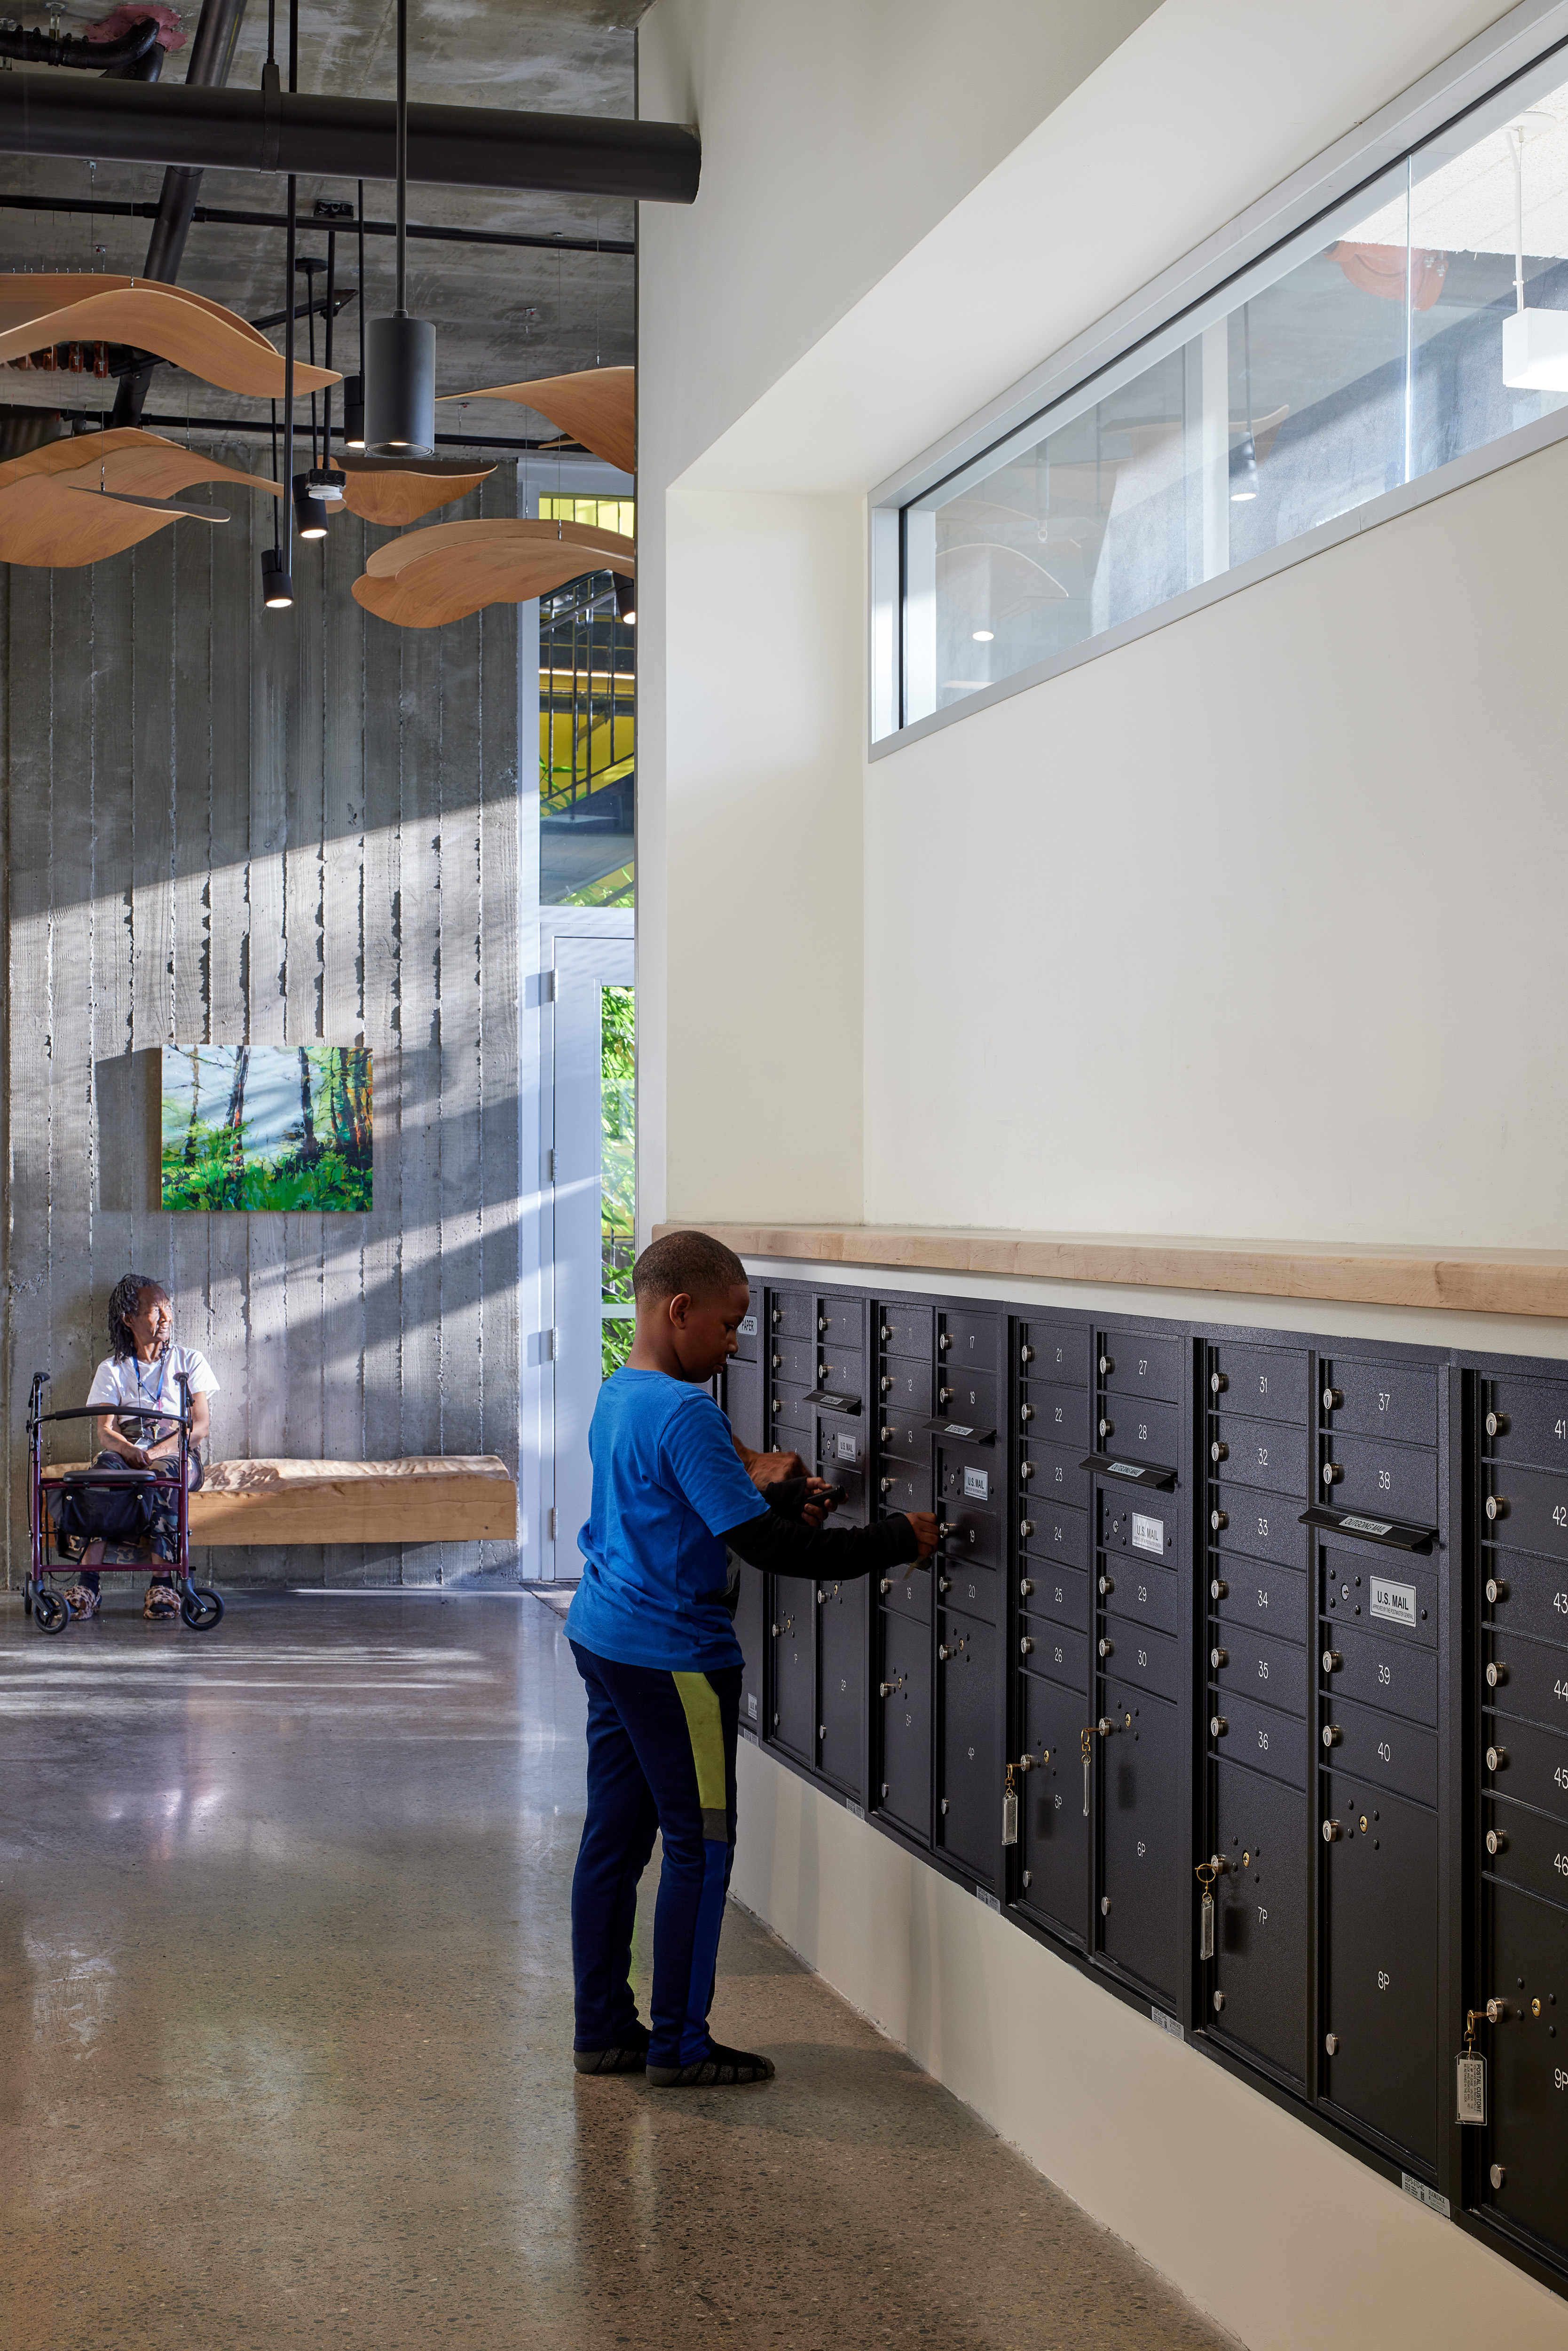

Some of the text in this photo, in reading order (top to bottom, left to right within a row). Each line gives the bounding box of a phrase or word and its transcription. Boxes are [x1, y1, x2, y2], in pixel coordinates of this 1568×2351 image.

[969, 1336, 975, 1349] 17
[1056, 1348, 1062, 1362] 21
[1139, 1360, 1147, 1375] 27
[1260, 1376, 1267, 1393] 31
[970, 1391, 975, 1404] 18
[1379, 1393, 1390, 1411] 37
[1055, 1407, 1062, 1422] 22
[908, 1430, 913, 1443] 13
[1139, 1424, 1147, 1440] 28
[1554, 1420, 1566, 1440] 41
[1258, 1448, 1268, 1466] 32
[1056, 1467, 1063, 1482] 23
[1111, 1464, 1132, 1473] OUTGOING
[976, 1478, 984, 1489] MAIL
[1379, 1470, 1390, 1490] 38
[908, 1483, 913, 1495] 14
[1345, 1519, 1374, 1530] OUTGOING
[1552, 1506, 1567, 1527] 42
[1055, 1526, 1062, 1542] 24
[1137, 1525, 1158, 1541] U.S. MAIL
[1258, 1518, 1268, 1536] 33
[969, 1530, 975, 1543] 19
[969, 1584, 976, 1598] 20
[1055, 1587, 1063, 1602] 25
[1138, 1586, 1147, 1602] 29
[1258, 1590, 1268, 1608] 34
[1378, 1591, 1409, 1610] U.S. MAIL
[1553, 1592, 1568, 1614] 43
[1055, 1647, 1062, 1663] 26
[1138, 1649, 1147, 1667] 30
[1258, 1660, 1269, 1679] 35
[1378, 1665, 1390, 1685] 39
[841, 1679, 846, 1691] 2P
[1554, 1680, 1568, 1702] 44
[906, 1714, 911, 1727] 3P
[1258, 1731, 1269, 1750] 36
[968, 1747, 975, 1760] 4P
[1378, 1742, 1390, 1762] 40
[1554, 1767, 1568, 1789] 45
[1055, 1794, 1062, 1810] 5P
[1137, 1841, 1146, 1857] 6P
[1554, 1853, 1568, 1876] 46
[1258, 1906, 1268, 1925] 7P
[1378, 1971, 1390, 1990] 8P
[1554, 2068, 1568, 2091] 9P
[1404, 2174, 1425, 2191] USPS-STD-4C
[1428, 2189, 1445, 2204] FLORENCE
